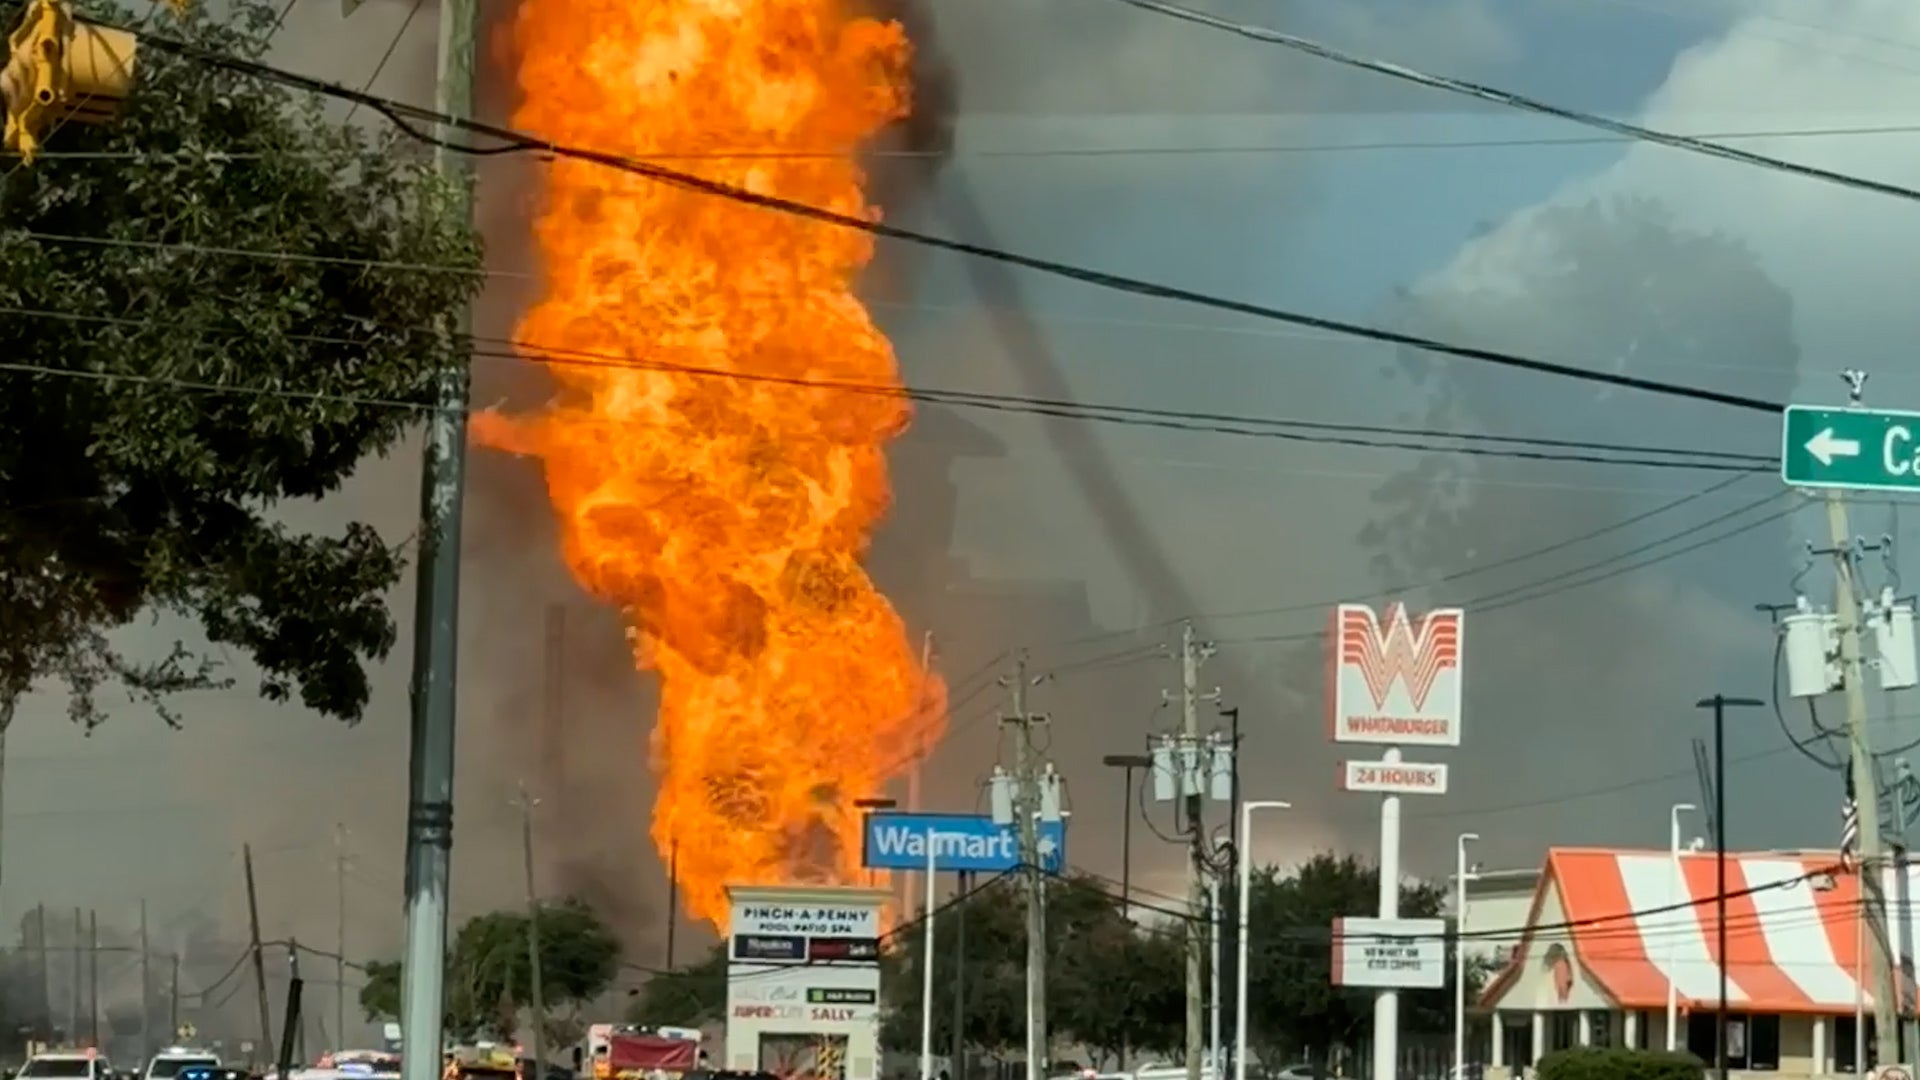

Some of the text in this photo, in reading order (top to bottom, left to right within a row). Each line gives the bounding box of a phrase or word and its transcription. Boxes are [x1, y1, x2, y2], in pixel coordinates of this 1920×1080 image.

[1347, 716, 1449, 736] WHATABURGER
[1357, 769, 1436, 786] 24 HOURS
[873, 825, 1013, 859] Walmart
[831, 924, 852, 933] SPA
[811, 1008, 855, 1022] SALLY
